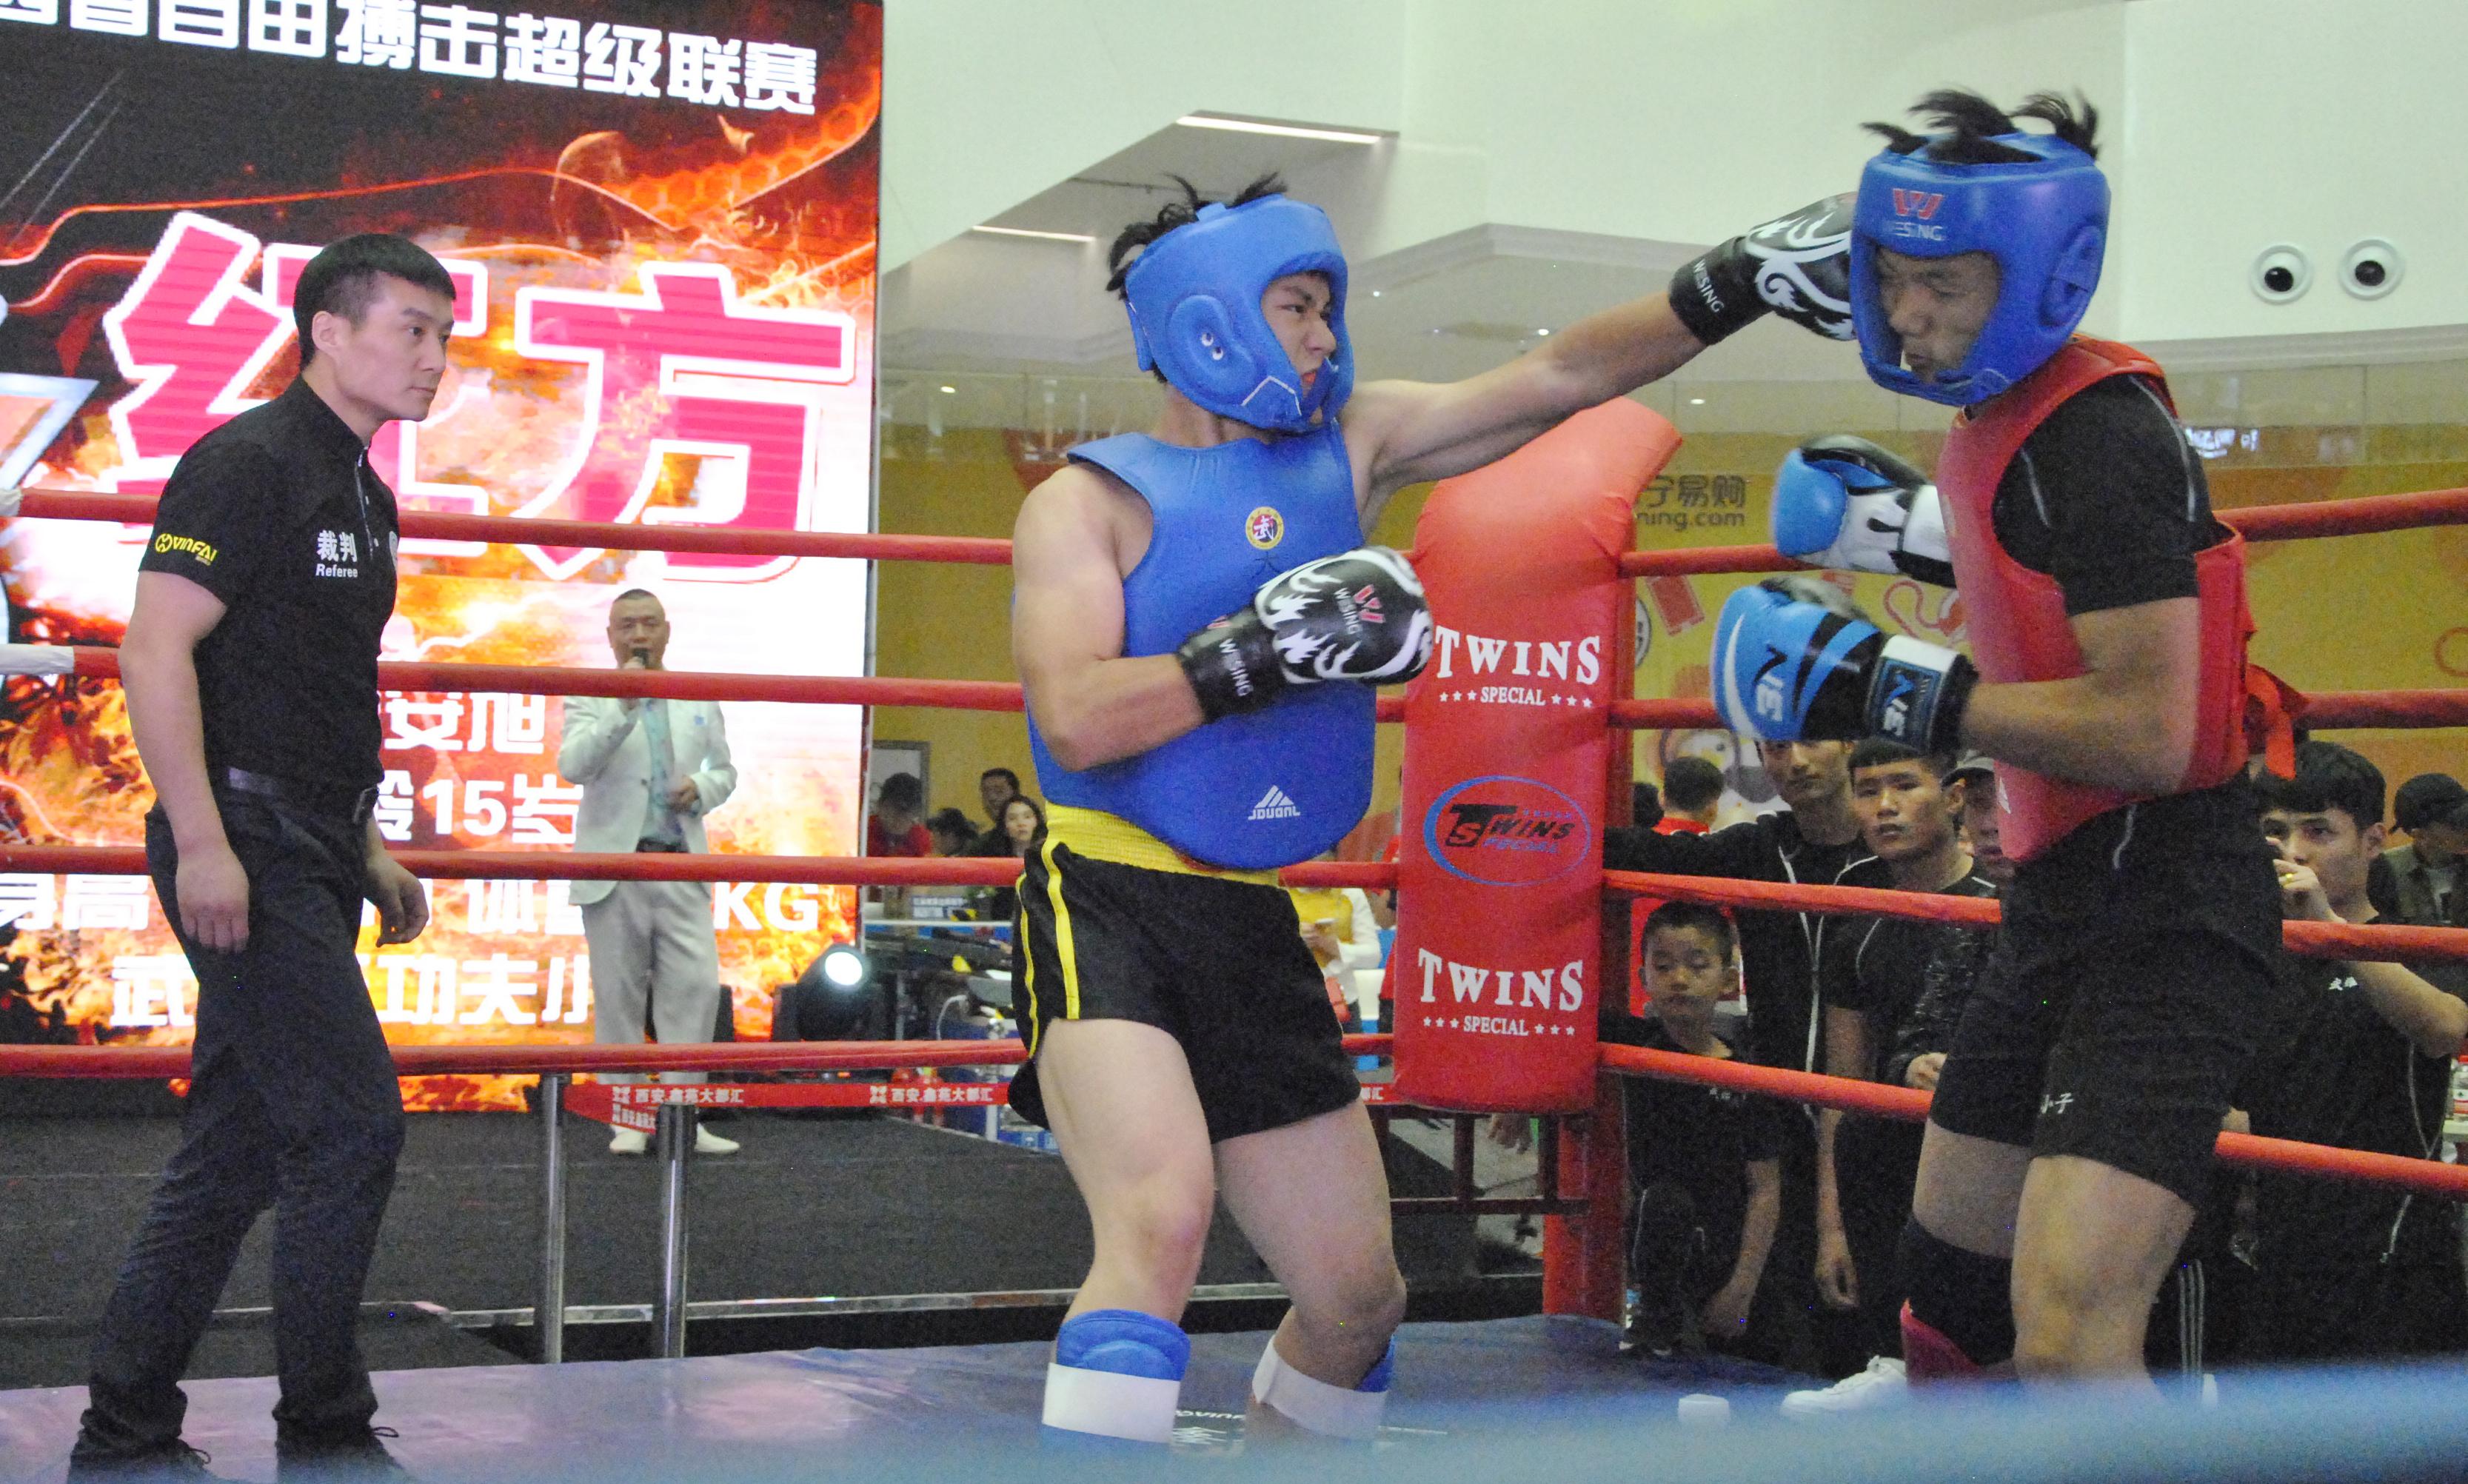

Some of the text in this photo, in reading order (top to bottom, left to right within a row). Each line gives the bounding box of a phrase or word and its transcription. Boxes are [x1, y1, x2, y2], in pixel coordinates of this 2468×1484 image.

[316, 529, 358, 562] 裁判
[315, 563, 358, 578] Referee
[1435, 625, 1600, 685] TWINS
[1481, 686, 1546, 706] SPECIAL
[712, 881, 819, 932] KG
[1418, 948, 1583, 1011] TWINS
[1463, 1015, 1529, 1036] SPECIAL
